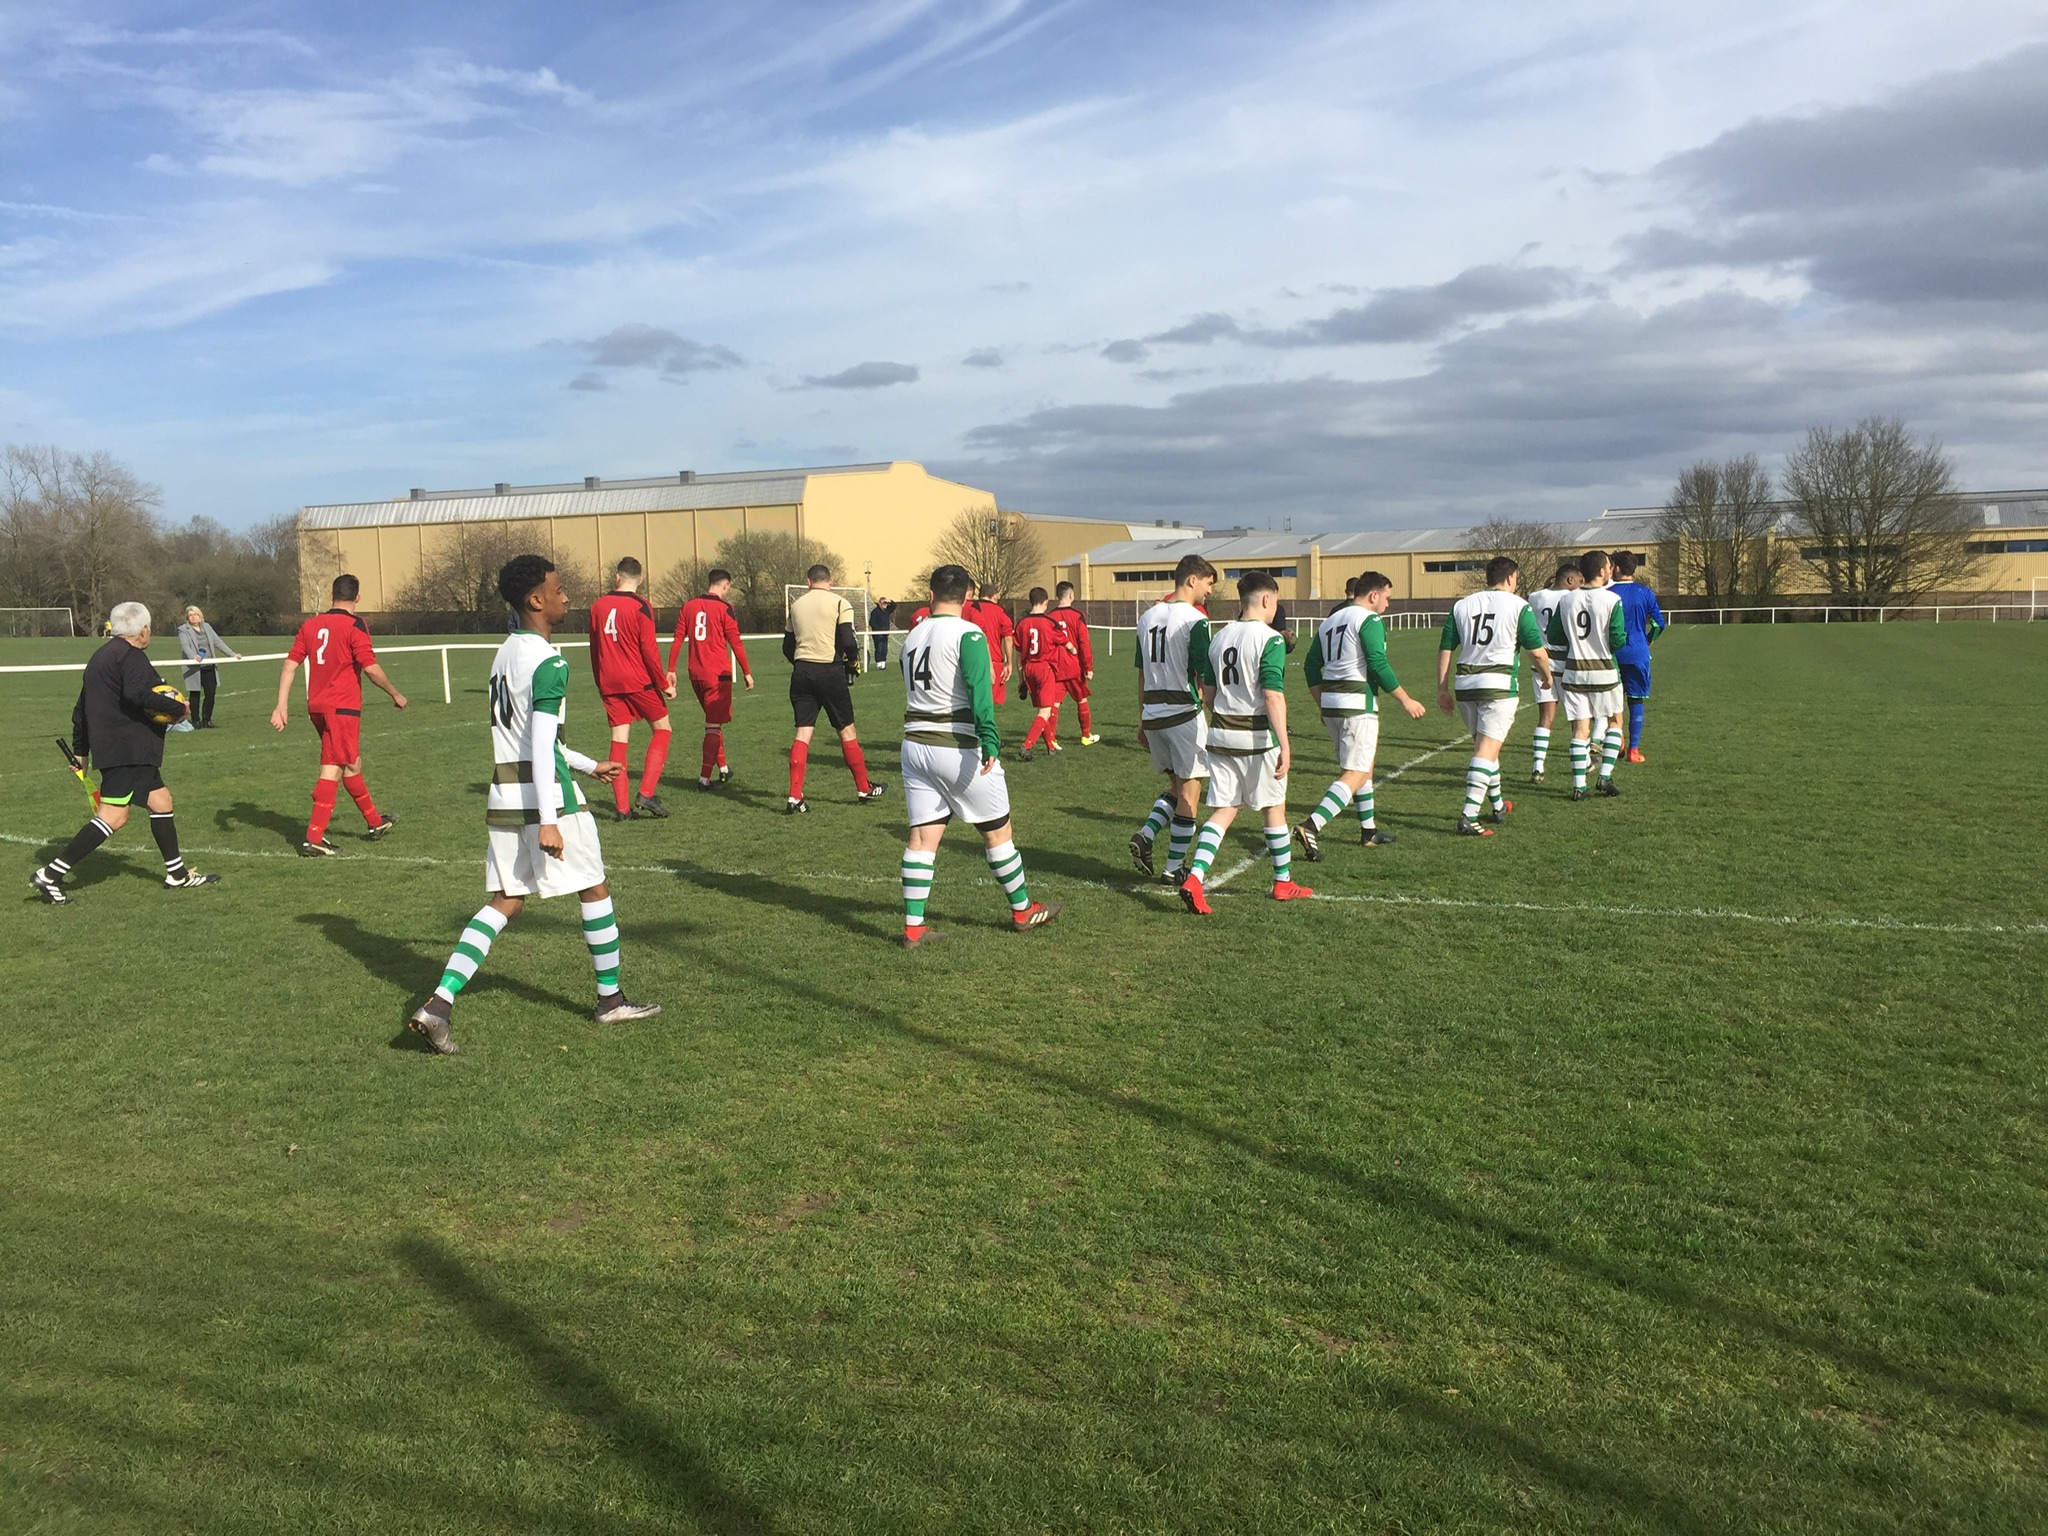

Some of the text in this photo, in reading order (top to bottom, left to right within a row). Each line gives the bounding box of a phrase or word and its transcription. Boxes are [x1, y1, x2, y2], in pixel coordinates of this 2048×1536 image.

[604, 608, 618, 642] 4
[694, 611, 707, 641] 8
[1029, 628, 1039, 655] 3
[1149, 624, 1167, 664] 11
[1325, 623, 1348, 662] 17
[1471, 613, 1496, 646] 15
[1576, 610, 1592, 641] 9
[316, 627, 330, 665] 2
[907, 645, 932, 692] 14
[1222, 646, 1240, 686] 8
[489, 672, 514, 730] 10
